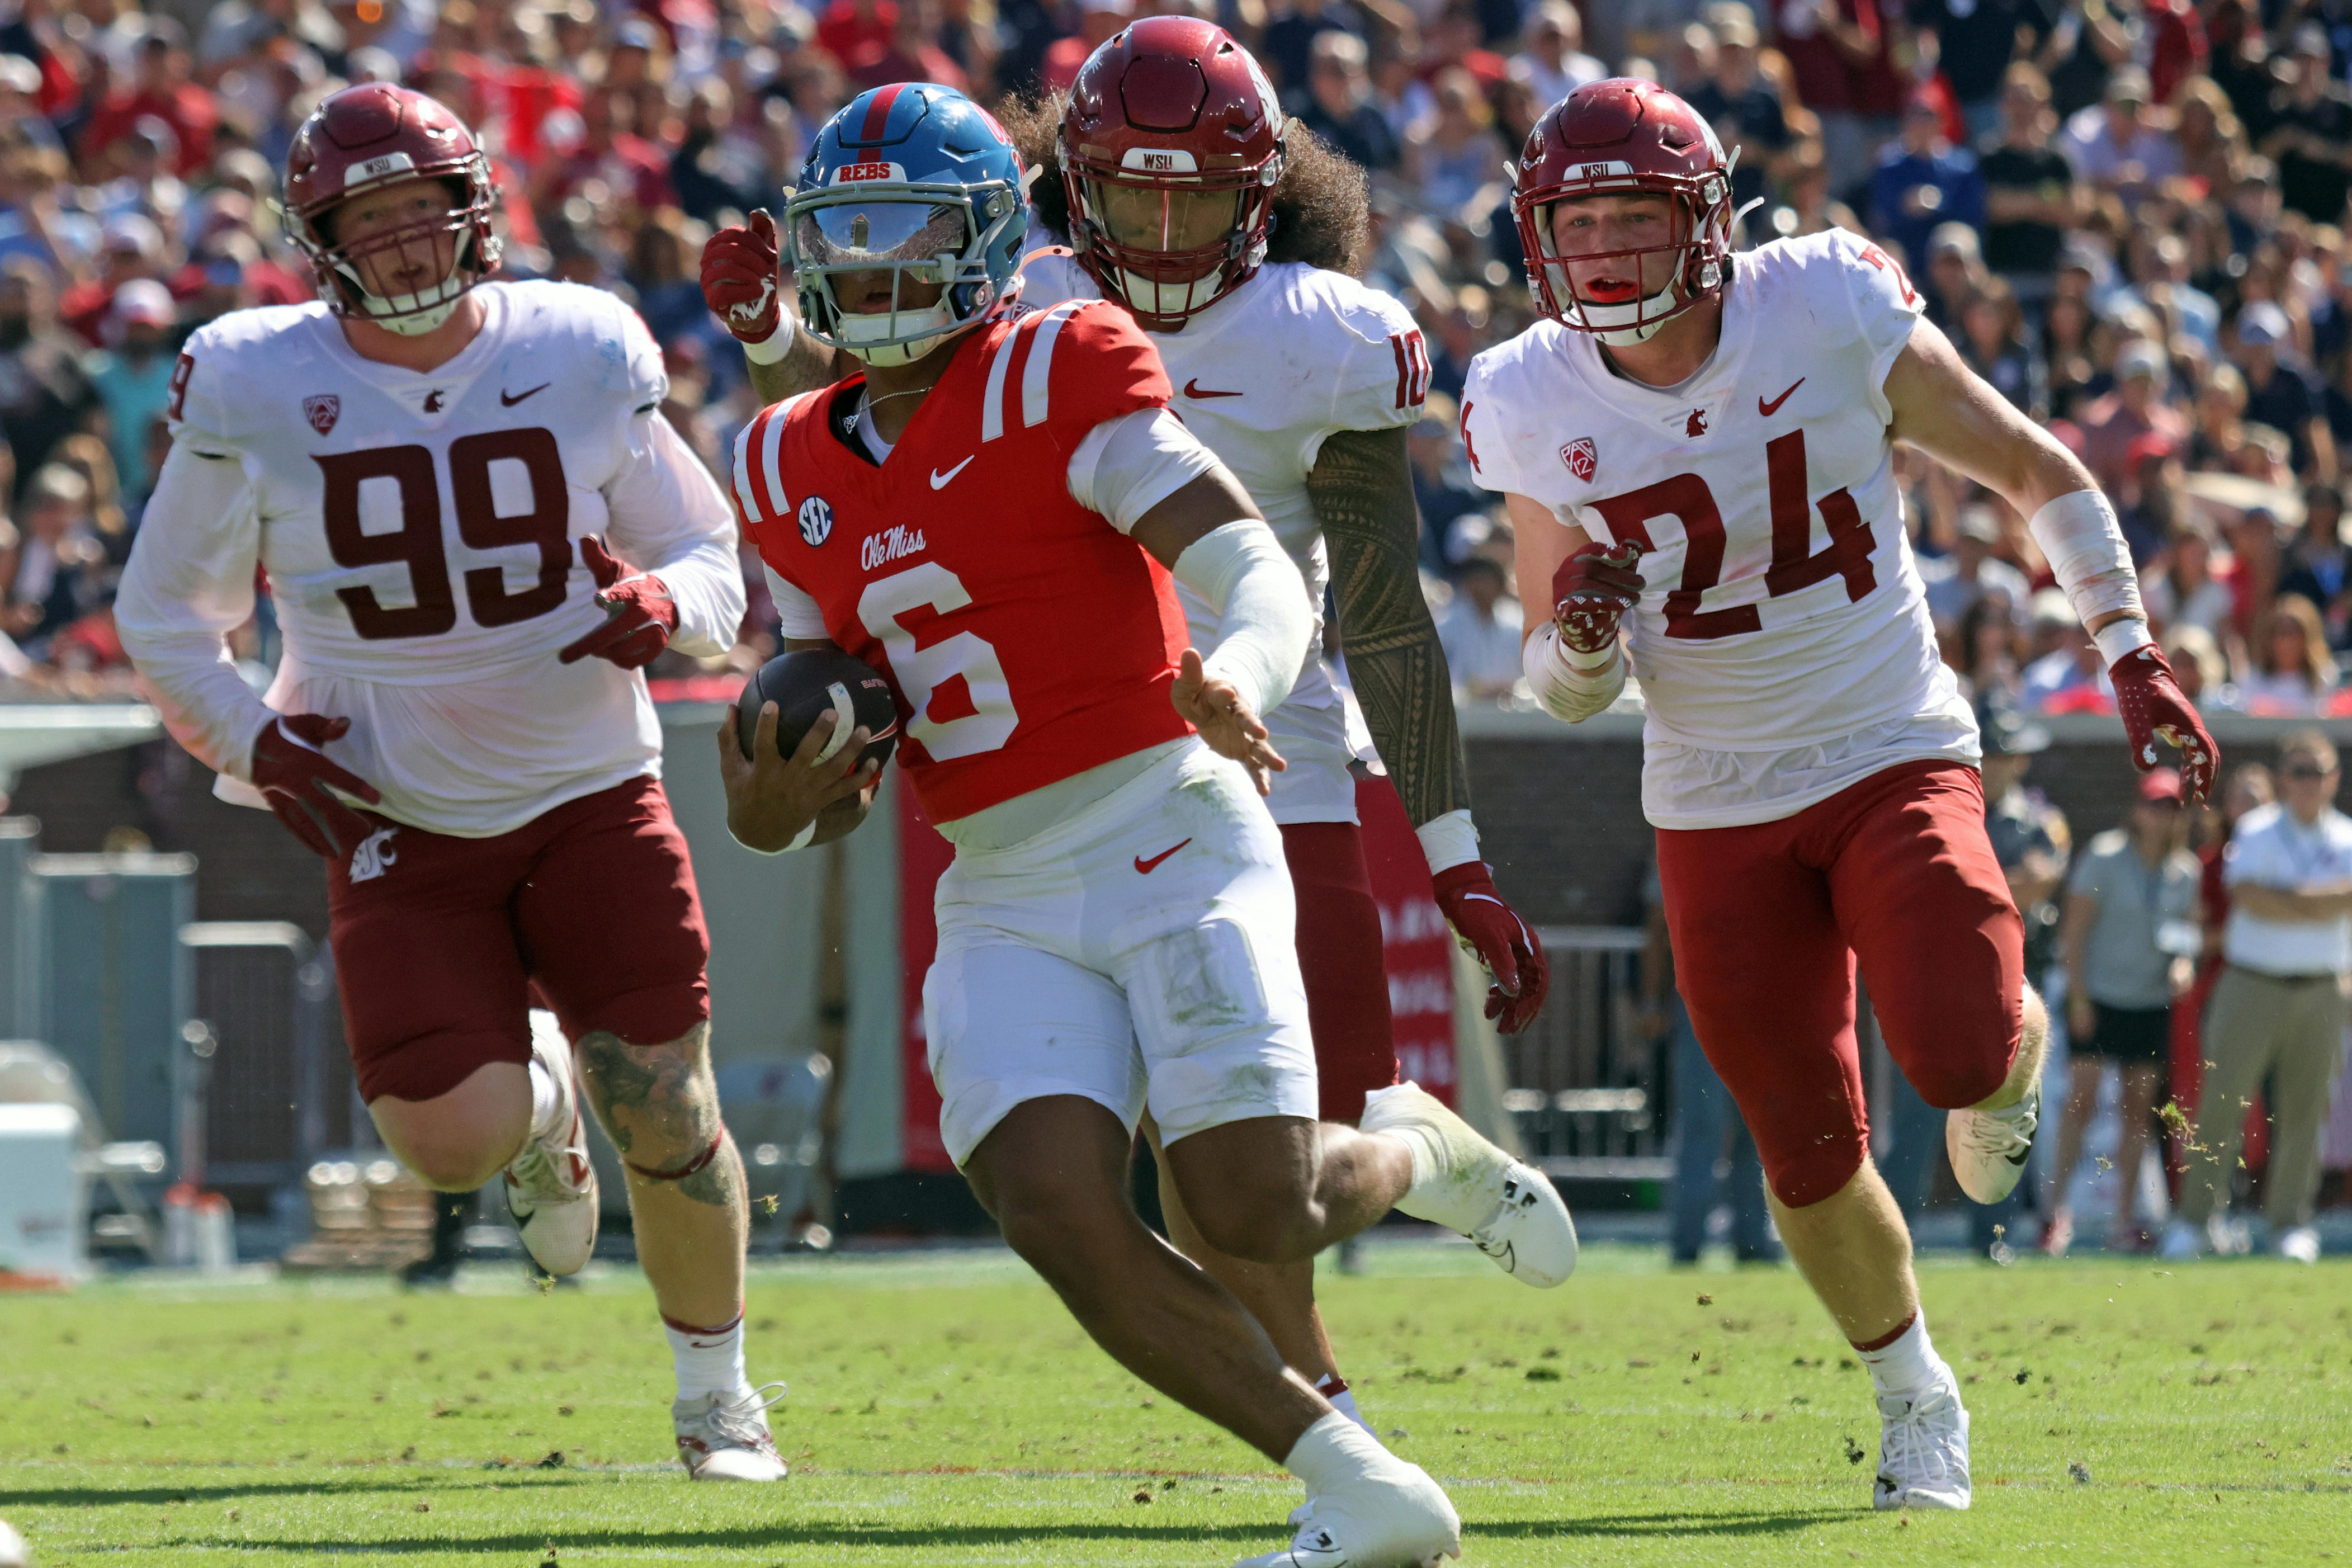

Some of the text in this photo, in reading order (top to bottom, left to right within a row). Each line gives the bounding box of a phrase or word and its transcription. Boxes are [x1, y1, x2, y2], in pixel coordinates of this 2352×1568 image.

[362, 157, 390, 175] WSU
[839, 163, 890, 182] REBS
[1144, 154, 1172, 171] WSU
[1581, 163, 1609, 178] WSU
[1010, 303, 1038, 321] PA
[1387, 329, 1428, 409] 10
[304, 396, 338, 420] PAC
[314, 412, 332, 428] 12
[1560, 440, 1595, 471] PAC
[1573, 457, 1593, 476] 12
[309, 427, 573, 640] 99
[799, 497, 832, 546] SEC
[1583, 428, 1878, 640] 24
[861, 524, 927, 571] Ole Miss
[857, 561, 1019, 763] 6
